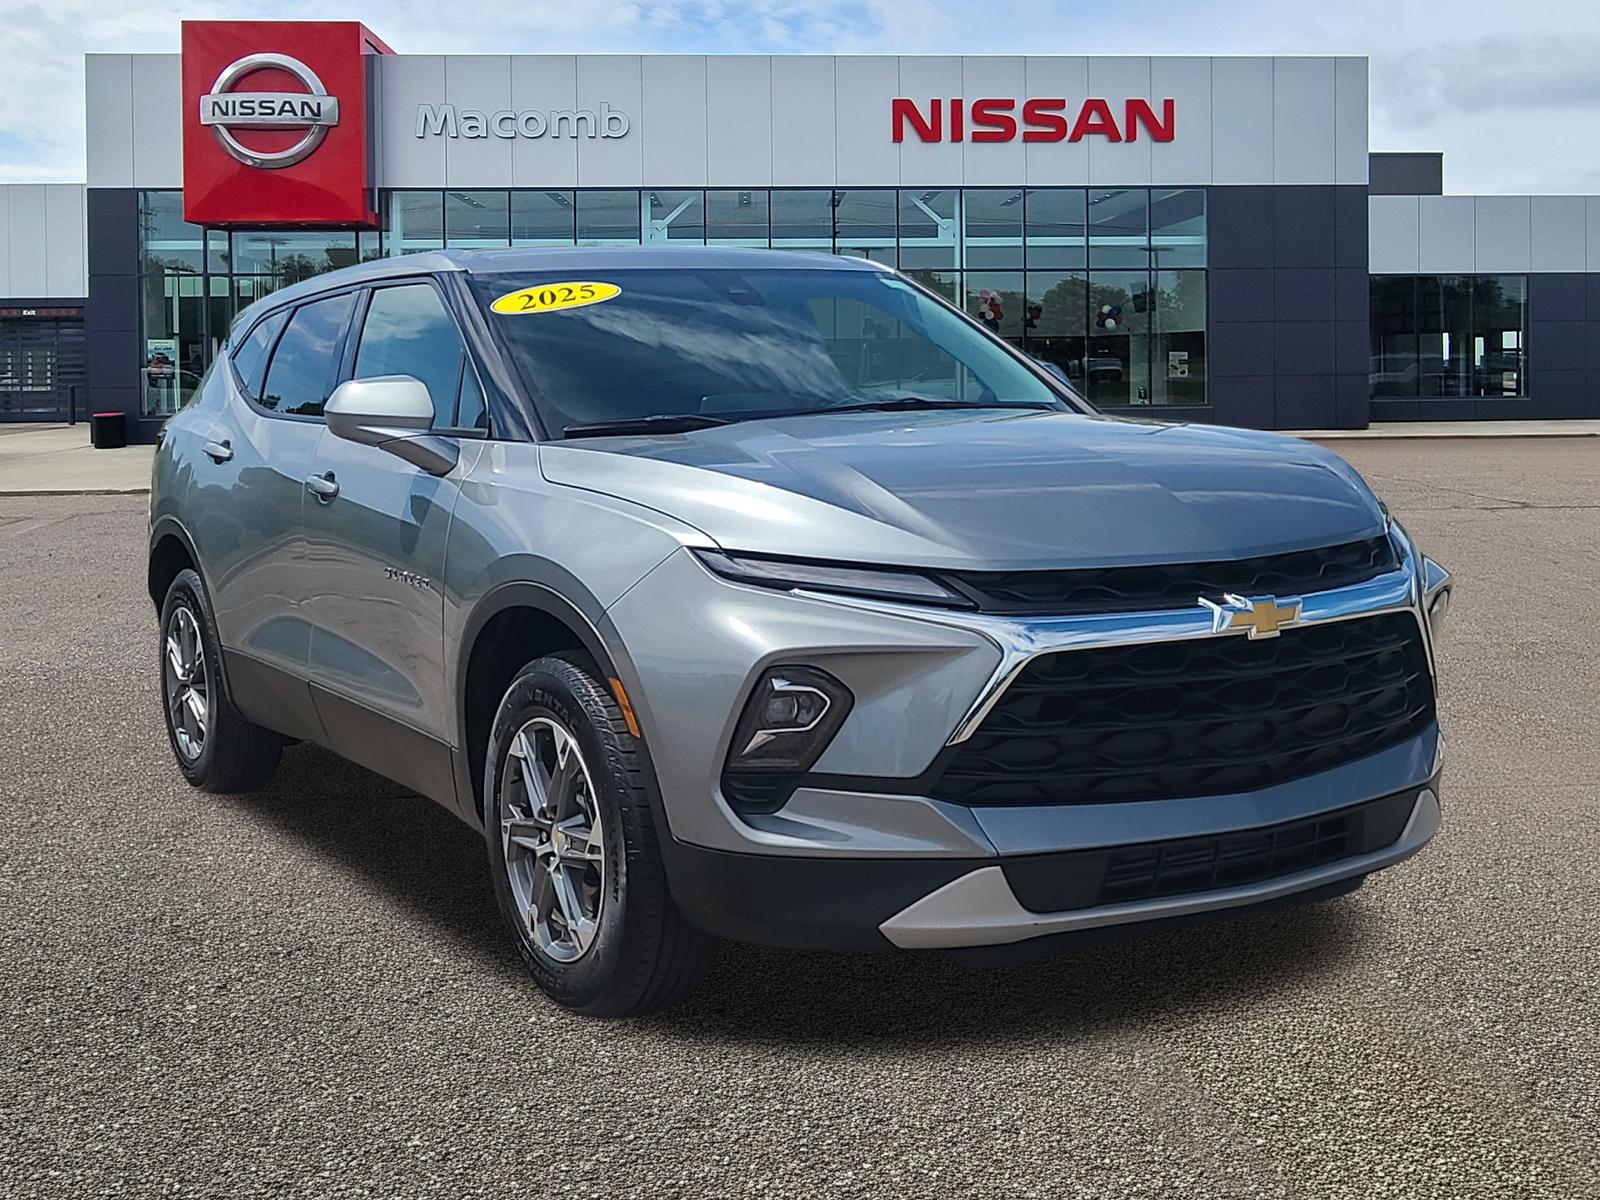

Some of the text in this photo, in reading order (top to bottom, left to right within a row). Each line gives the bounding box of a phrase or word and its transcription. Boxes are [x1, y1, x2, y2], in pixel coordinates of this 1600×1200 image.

[211, 99, 322, 118] NISSAN
[414, 101, 630, 139] Macomb
[892, 98, 1176, 143] NISSAN
[518, 284, 596, 311] 2025
